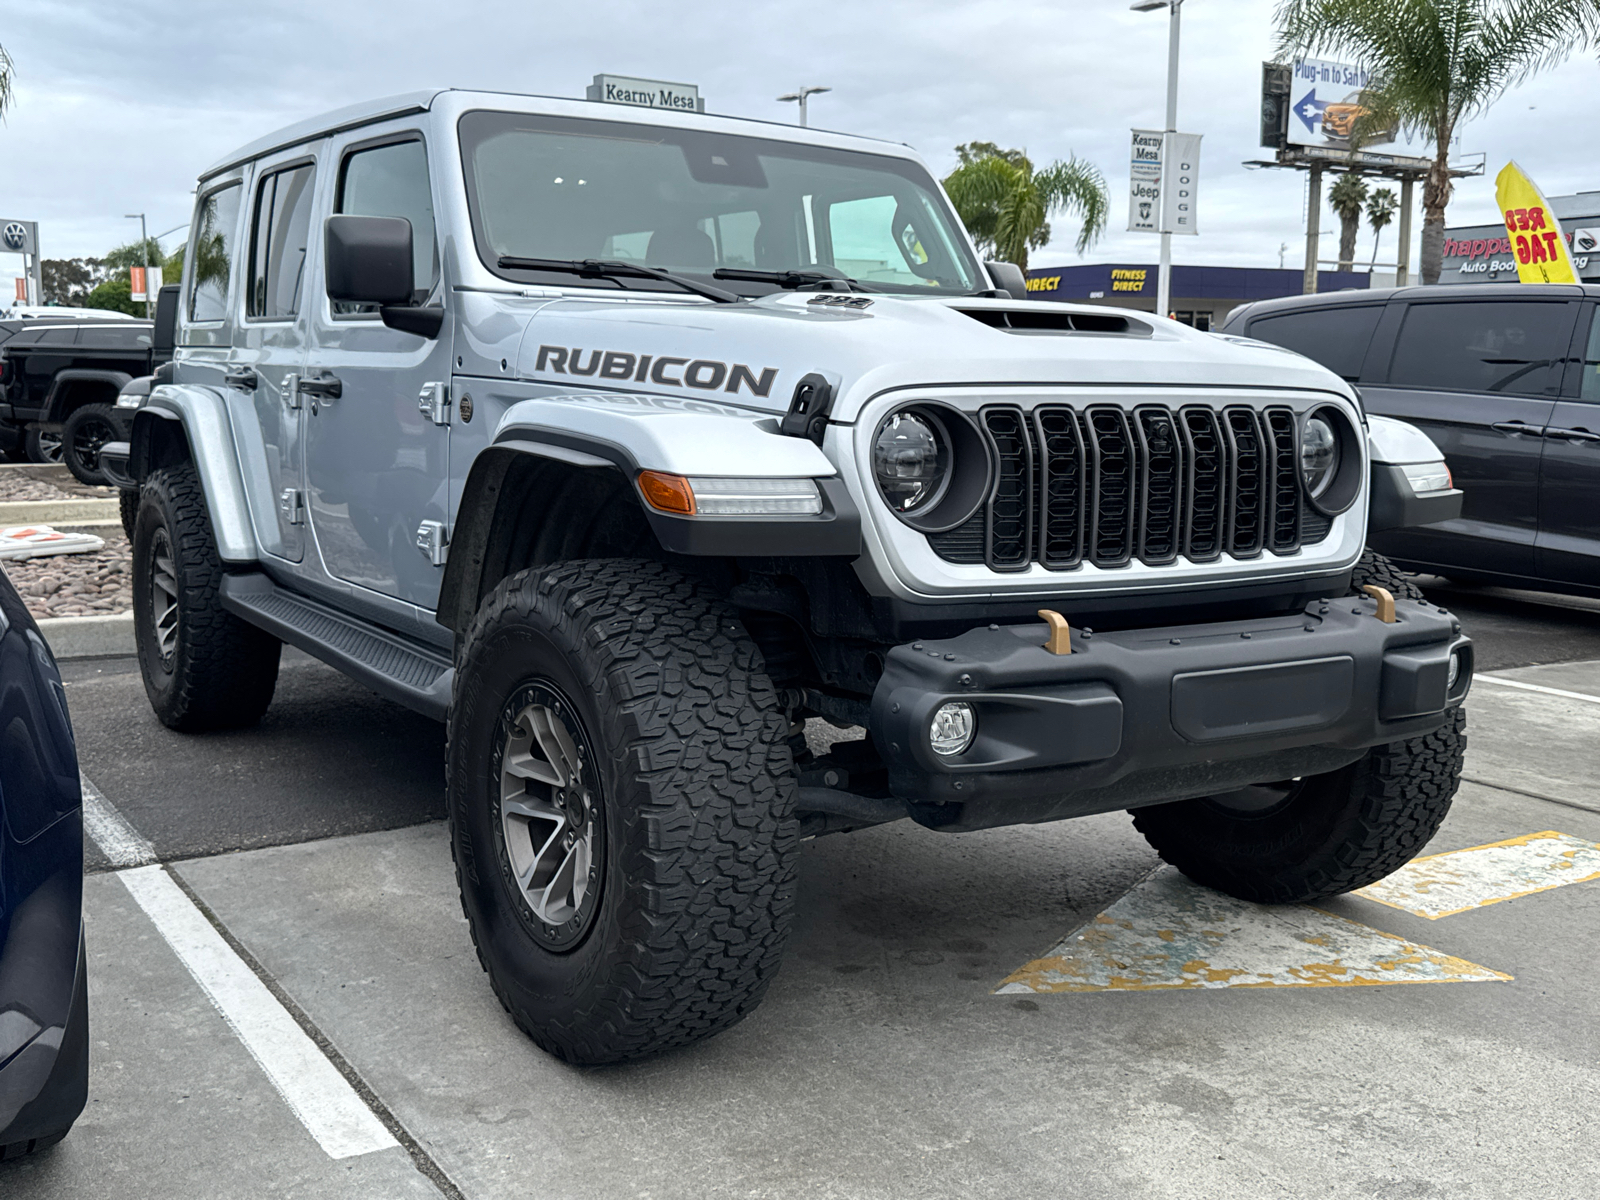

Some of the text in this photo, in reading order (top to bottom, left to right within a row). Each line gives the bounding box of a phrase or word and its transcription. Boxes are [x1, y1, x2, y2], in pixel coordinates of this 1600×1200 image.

[1295, 61, 1330, 83] Plug-in
[1332, 66, 1341, 84] to
[1343, 67, 1359, 87] San
[606, 84, 695, 109] Kearny Mesa
[1132, 134, 1162, 150] Kearny
[1136, 148, 1159, 160] Mesa
[1132, 184, 1159, 200] Jeep
[1177, 162, 1191, 225] DODGE
[1111, 270, 1147, 280] FITNESS
[1459, 261, 1487, 273] Auto
[1112, 281, 1145, 291] DIRECT
[535, 345, 779, 398] RUBICON
